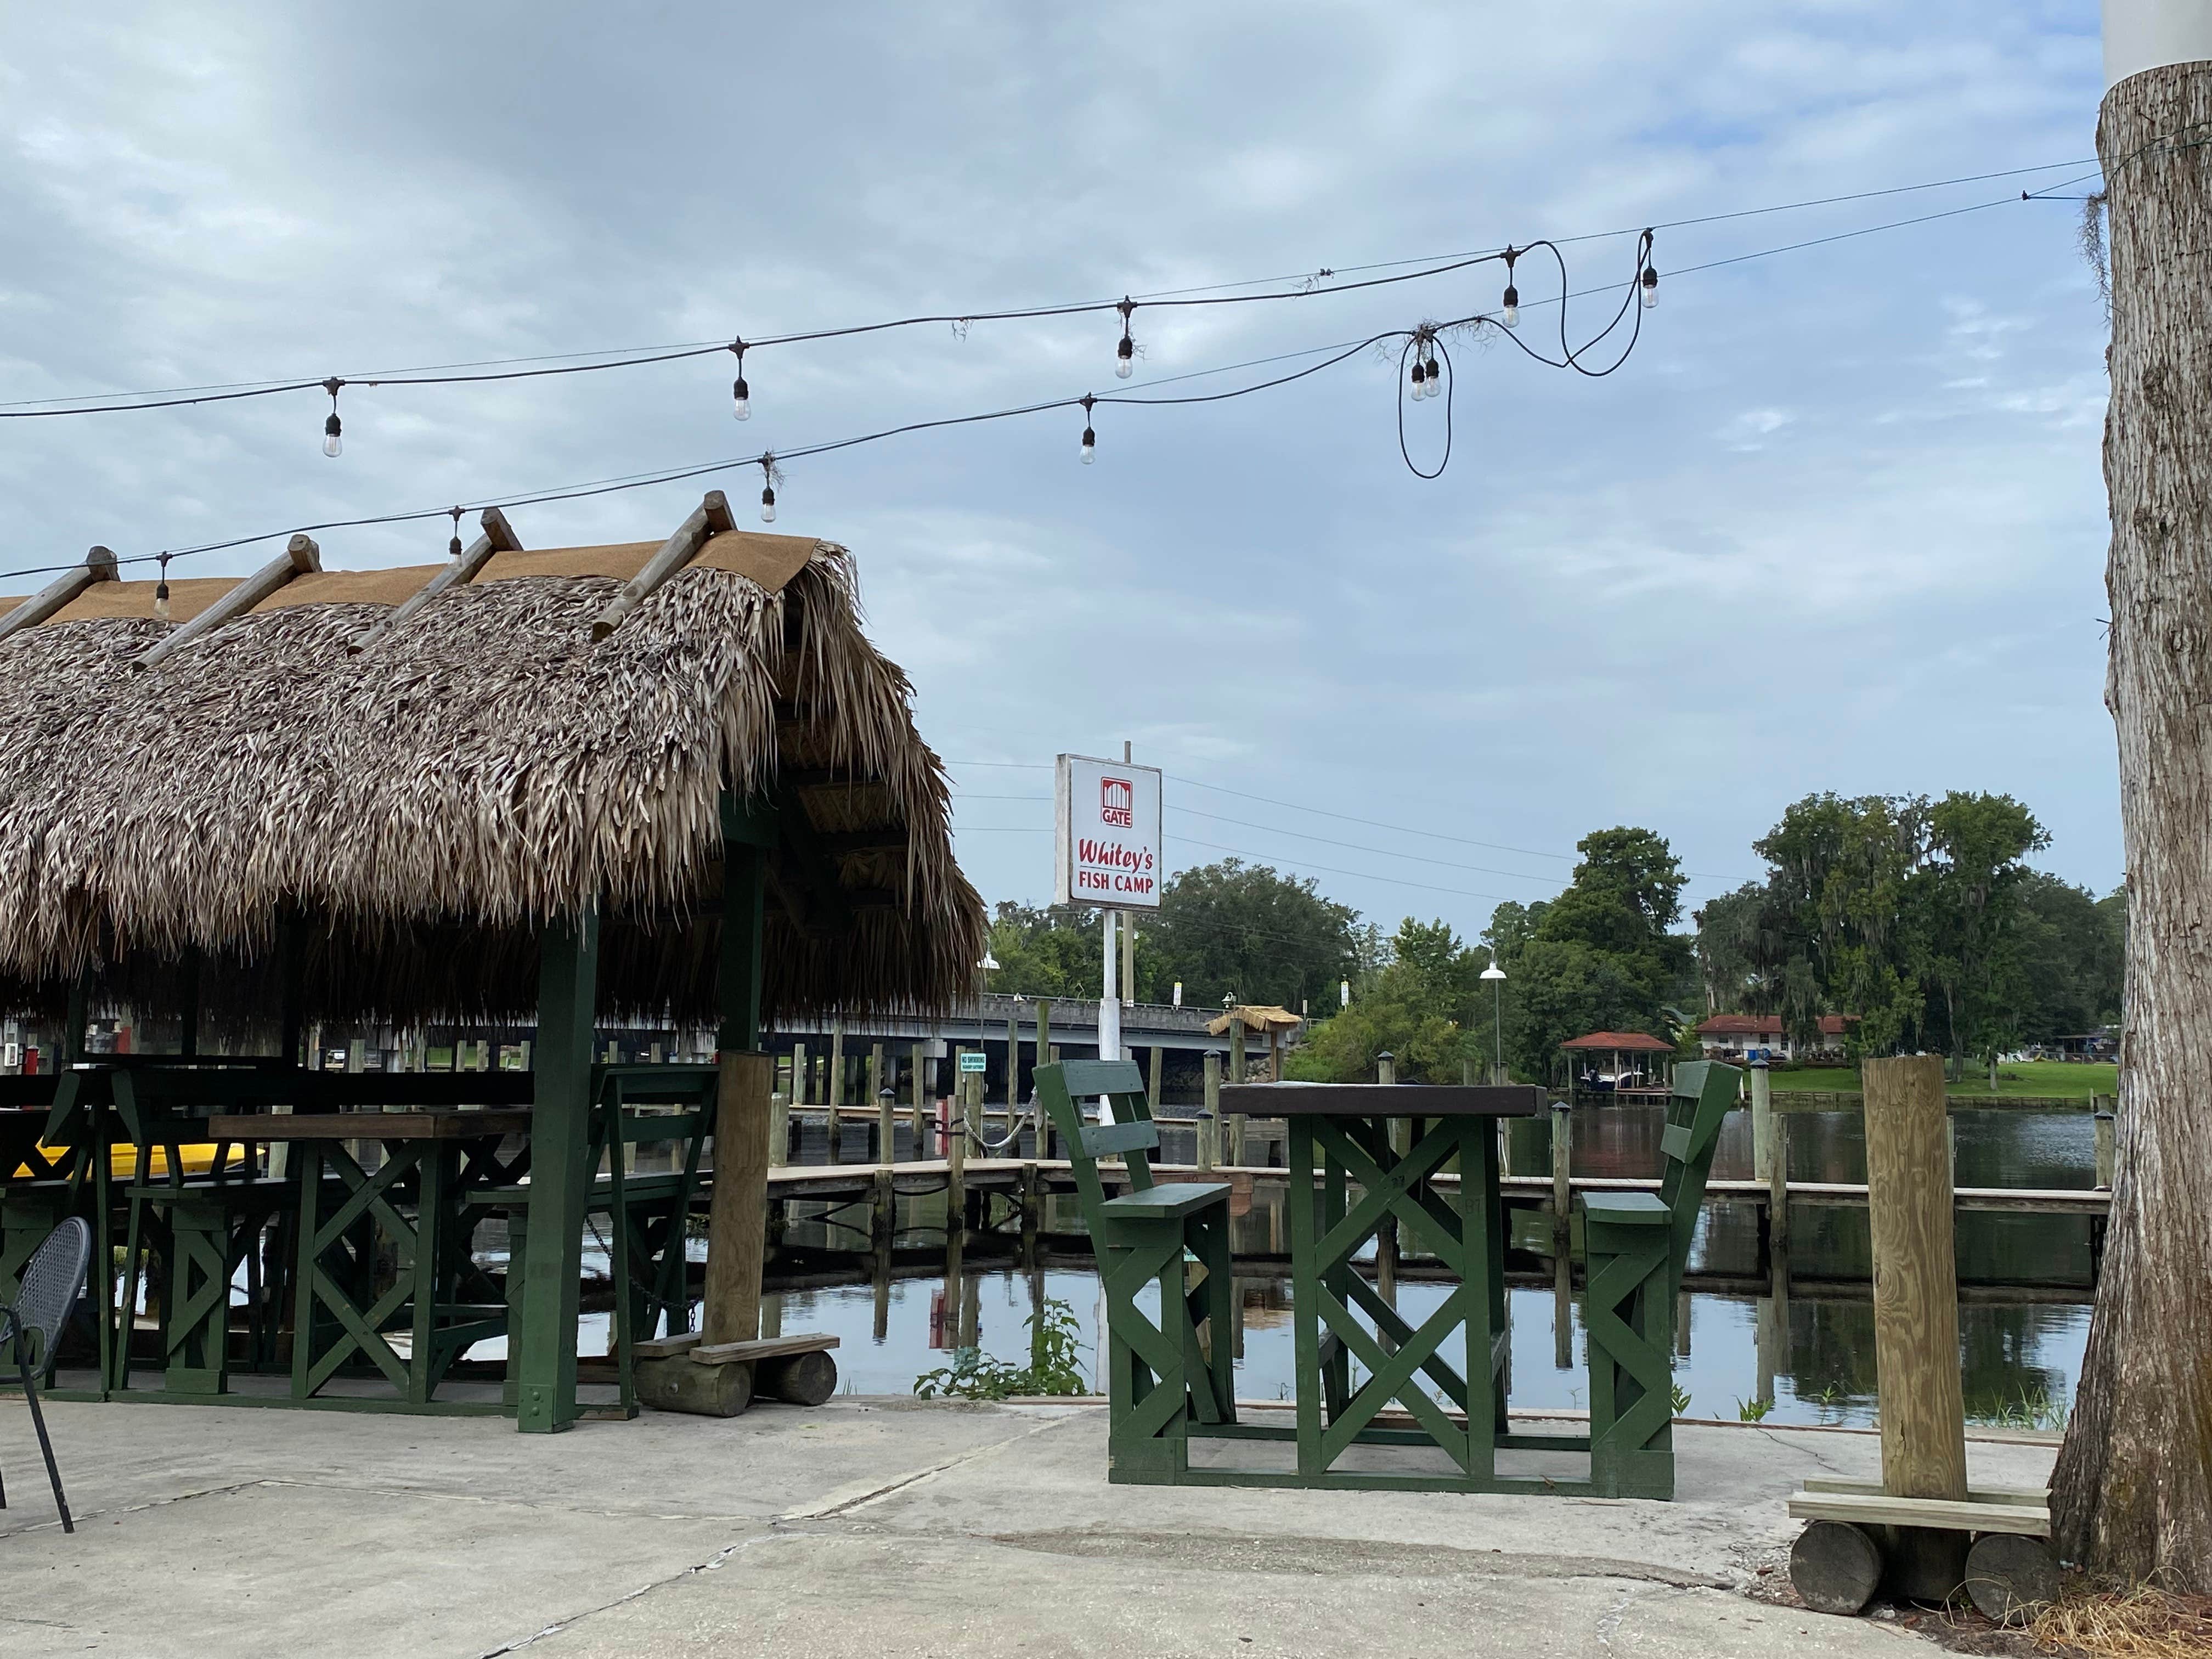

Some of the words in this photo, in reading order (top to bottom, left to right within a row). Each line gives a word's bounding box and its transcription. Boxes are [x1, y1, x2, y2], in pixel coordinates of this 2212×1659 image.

[1102, 809, 1131, 825] GATE
[1079, 838, 1153, 874] Whitey's
[1079, 871, 1109, 889] FISH
[1114, 875, 1153, 893] CAMP
